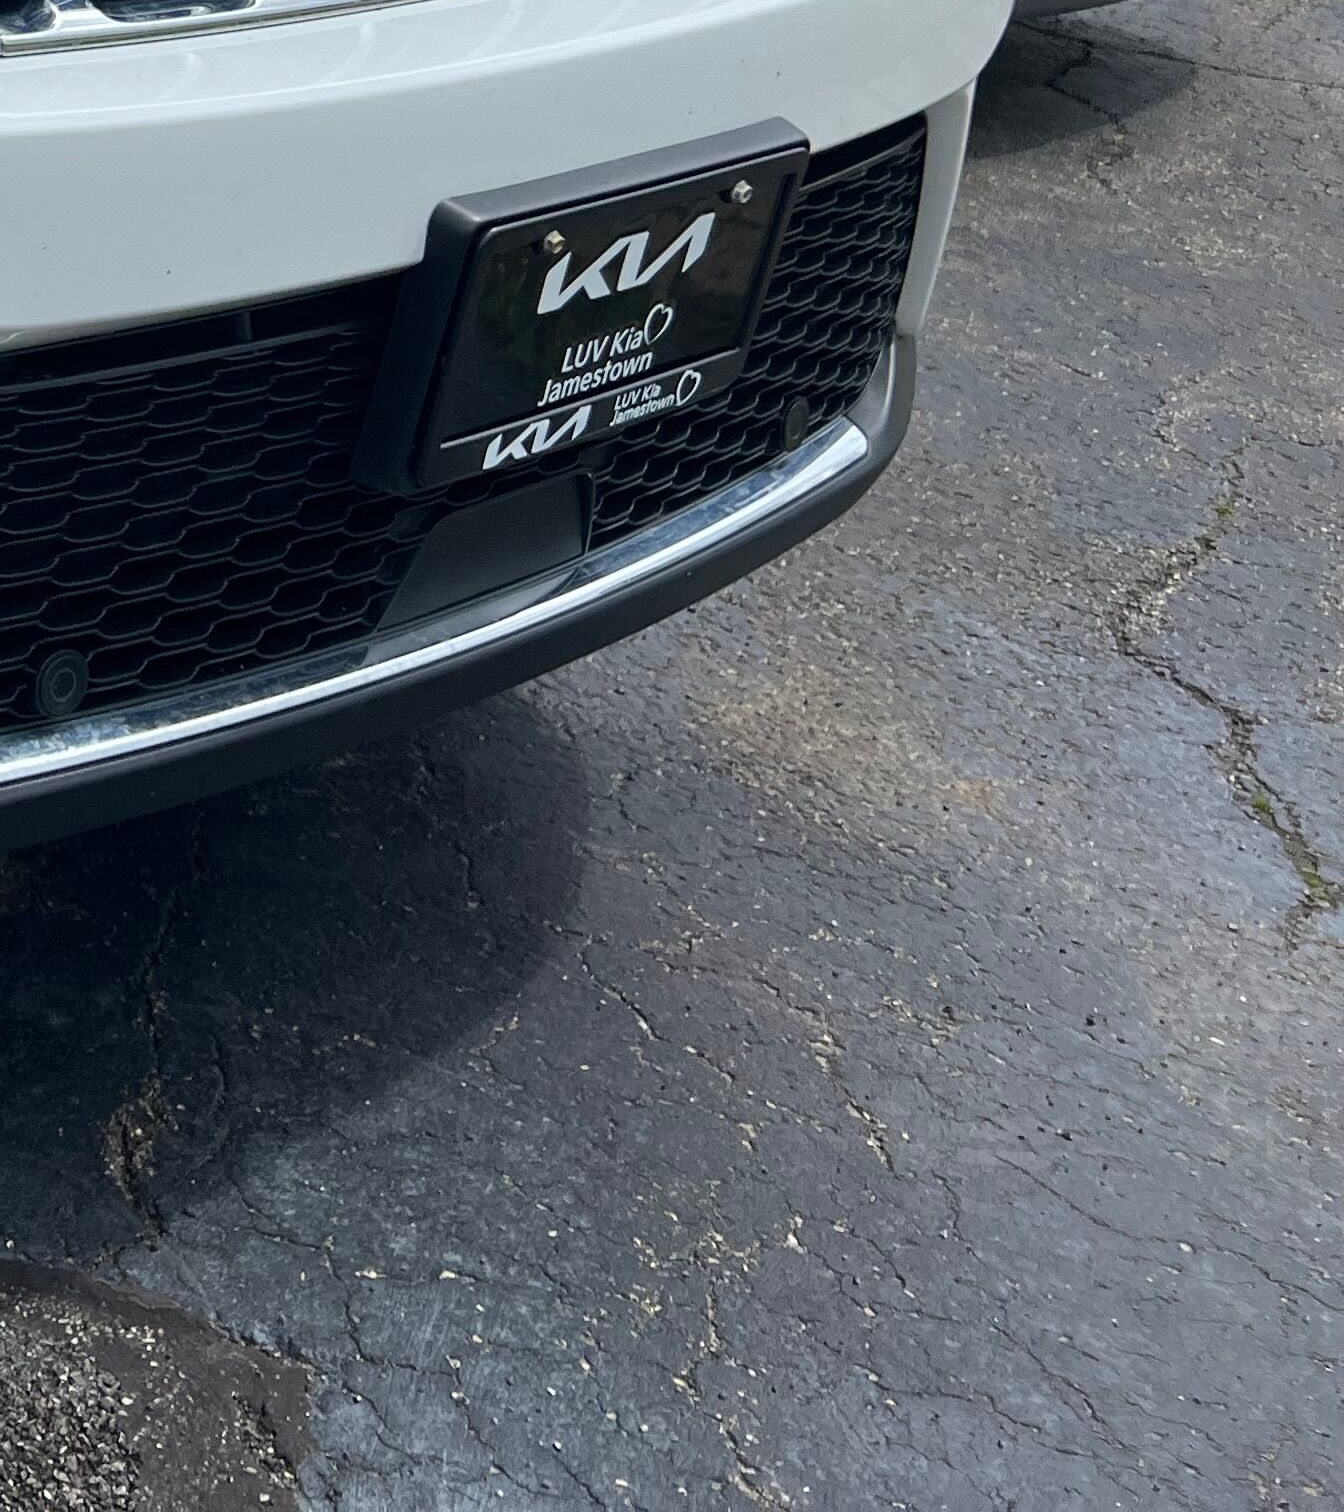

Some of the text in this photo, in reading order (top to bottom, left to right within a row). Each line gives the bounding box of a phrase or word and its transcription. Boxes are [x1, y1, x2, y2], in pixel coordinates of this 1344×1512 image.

[536, 211, 716, 315] KIA
[560, 326, 645, 374] LUV Kia
[536, 351, 654, 408] Jamestown
[613, 382, 662, 411] LUV Kia
[608, 393, 676, 427] Jamestown
[481, 404, 592, 471] KIA
